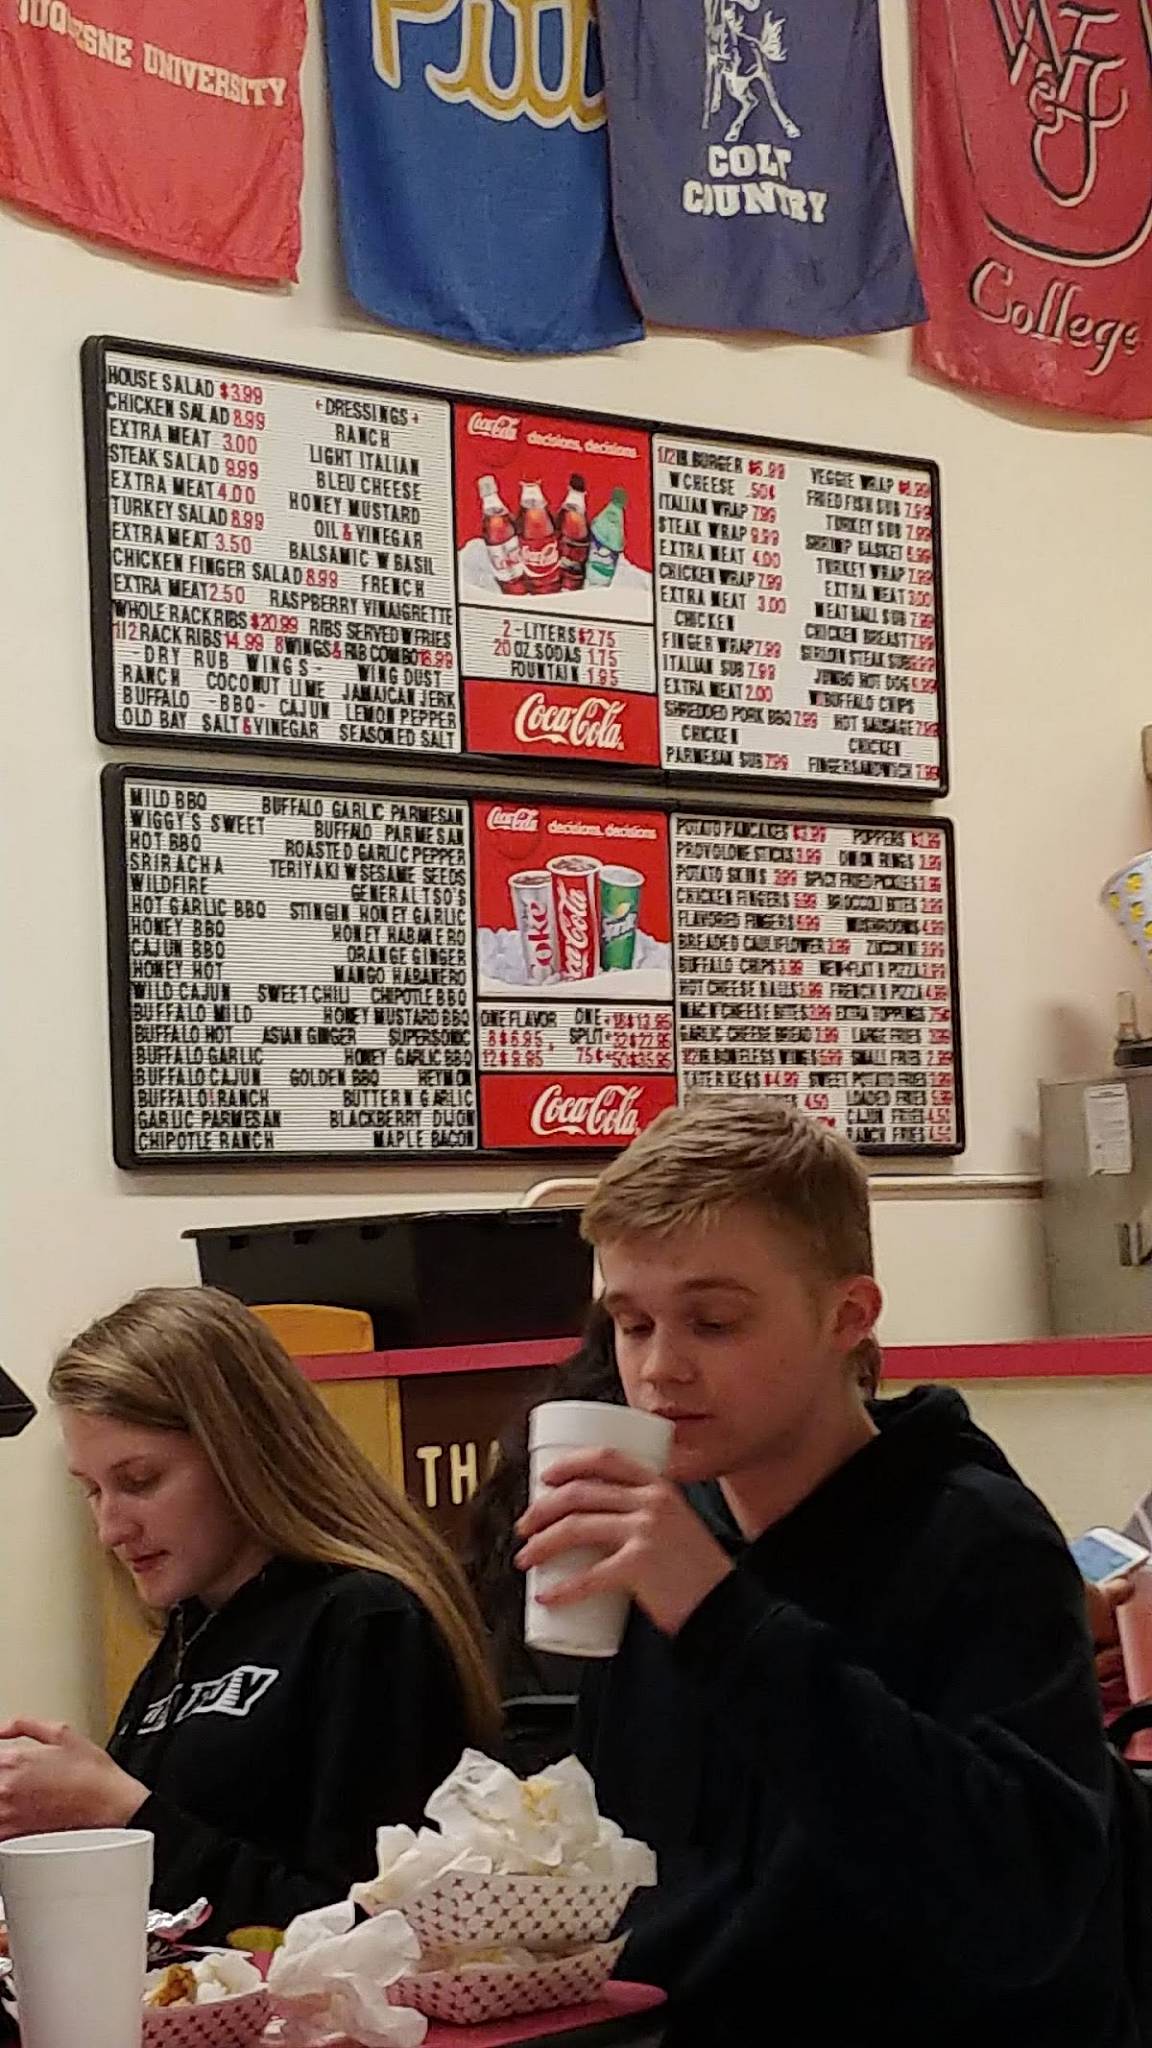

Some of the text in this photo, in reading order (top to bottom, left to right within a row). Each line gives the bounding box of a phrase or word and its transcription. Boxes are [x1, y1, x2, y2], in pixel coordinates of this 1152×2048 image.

[143, 42, 287, 107] UNIVERSITY
[707, 142, 792, 178] COLT
[968, 257, 1139, 377] College
[107, 365, 262, 405] HOUSE SALAD $3.99
[107, 391, 173, 417] CHICKEN
[179, 401, 229, 425] SALAD
[109, 417, 257, 454] EXTRA MEAT 3.00
[335, 423, 390, 447] RANCH
[109, 443, 158, 467] STEAK
[163, 450, 219, 475] SALAD
[310, 445, 420, 475] LIGHT ITALIAN
[110, 469, 255, 504] EXTRA MEAT 4.00
[316, 470, 422, 500] BLEU CHEESE
[112, 495, 173, 520] TURKEY
[177, 503, 227, 526] SALAD
[289, 491, 420, 524] HONEY MUSTARD
[112, 521, 251, 554] EXTRA MEAT 3.50
[314, 519, 338, 539] OIL
[356, 524, 423, 548] VINEGAR
[112, 547, 182, 572] CHICKEN
[189, 555, 245, 578] FINGER
[252, 562, 302, 584] SALAD
[289, 541, 369, 567] BALSAMIC
[393, 553, 434, 574] BASIL
[113, 573, 161, 595] EXTRA
[168, 578, 207, 600] MEAT
[361, 574, 424, 597] FRENCH
[114, 598, 165, 620] WHOLE
[269, 589, 357, 614] RASPBERRY
[144, 645, 179, 665] DRY
[194, 649, 228, 669] RUB
[122, 664, 180, 686] RANCH
[206, 671, 279, 694] COCONUT
[357, 663, 441, 687] WING DUST
[510, 660, 579, 683] FOUNTAIN
[123, 686, 189, 708] BUFFALO
[342, 683, 414, 705] JAMAICAN
[123, 707, 187, 729] OLD BAY
[279, 698, 329, 718] CAJUN
[346, 703, 456, 728] LEMON PEPPER
[202, 713, 238, 733] SALT
[254, 717, 319, 738] VINEGAR
[339, 723, 454, 748] SEASONED SALT
[128, 787, 207, 810] MILD BBQ
[261, 795, 323, 817] BUFFALO
[210, 814, 265, 834] SWEET
[314, 820, 372, 839] BUFFALO
[128, 831, 161, 850] HOT
[129, 852, 224, 874] SRIRACHA
[131, 895, 163, 914] HOT
